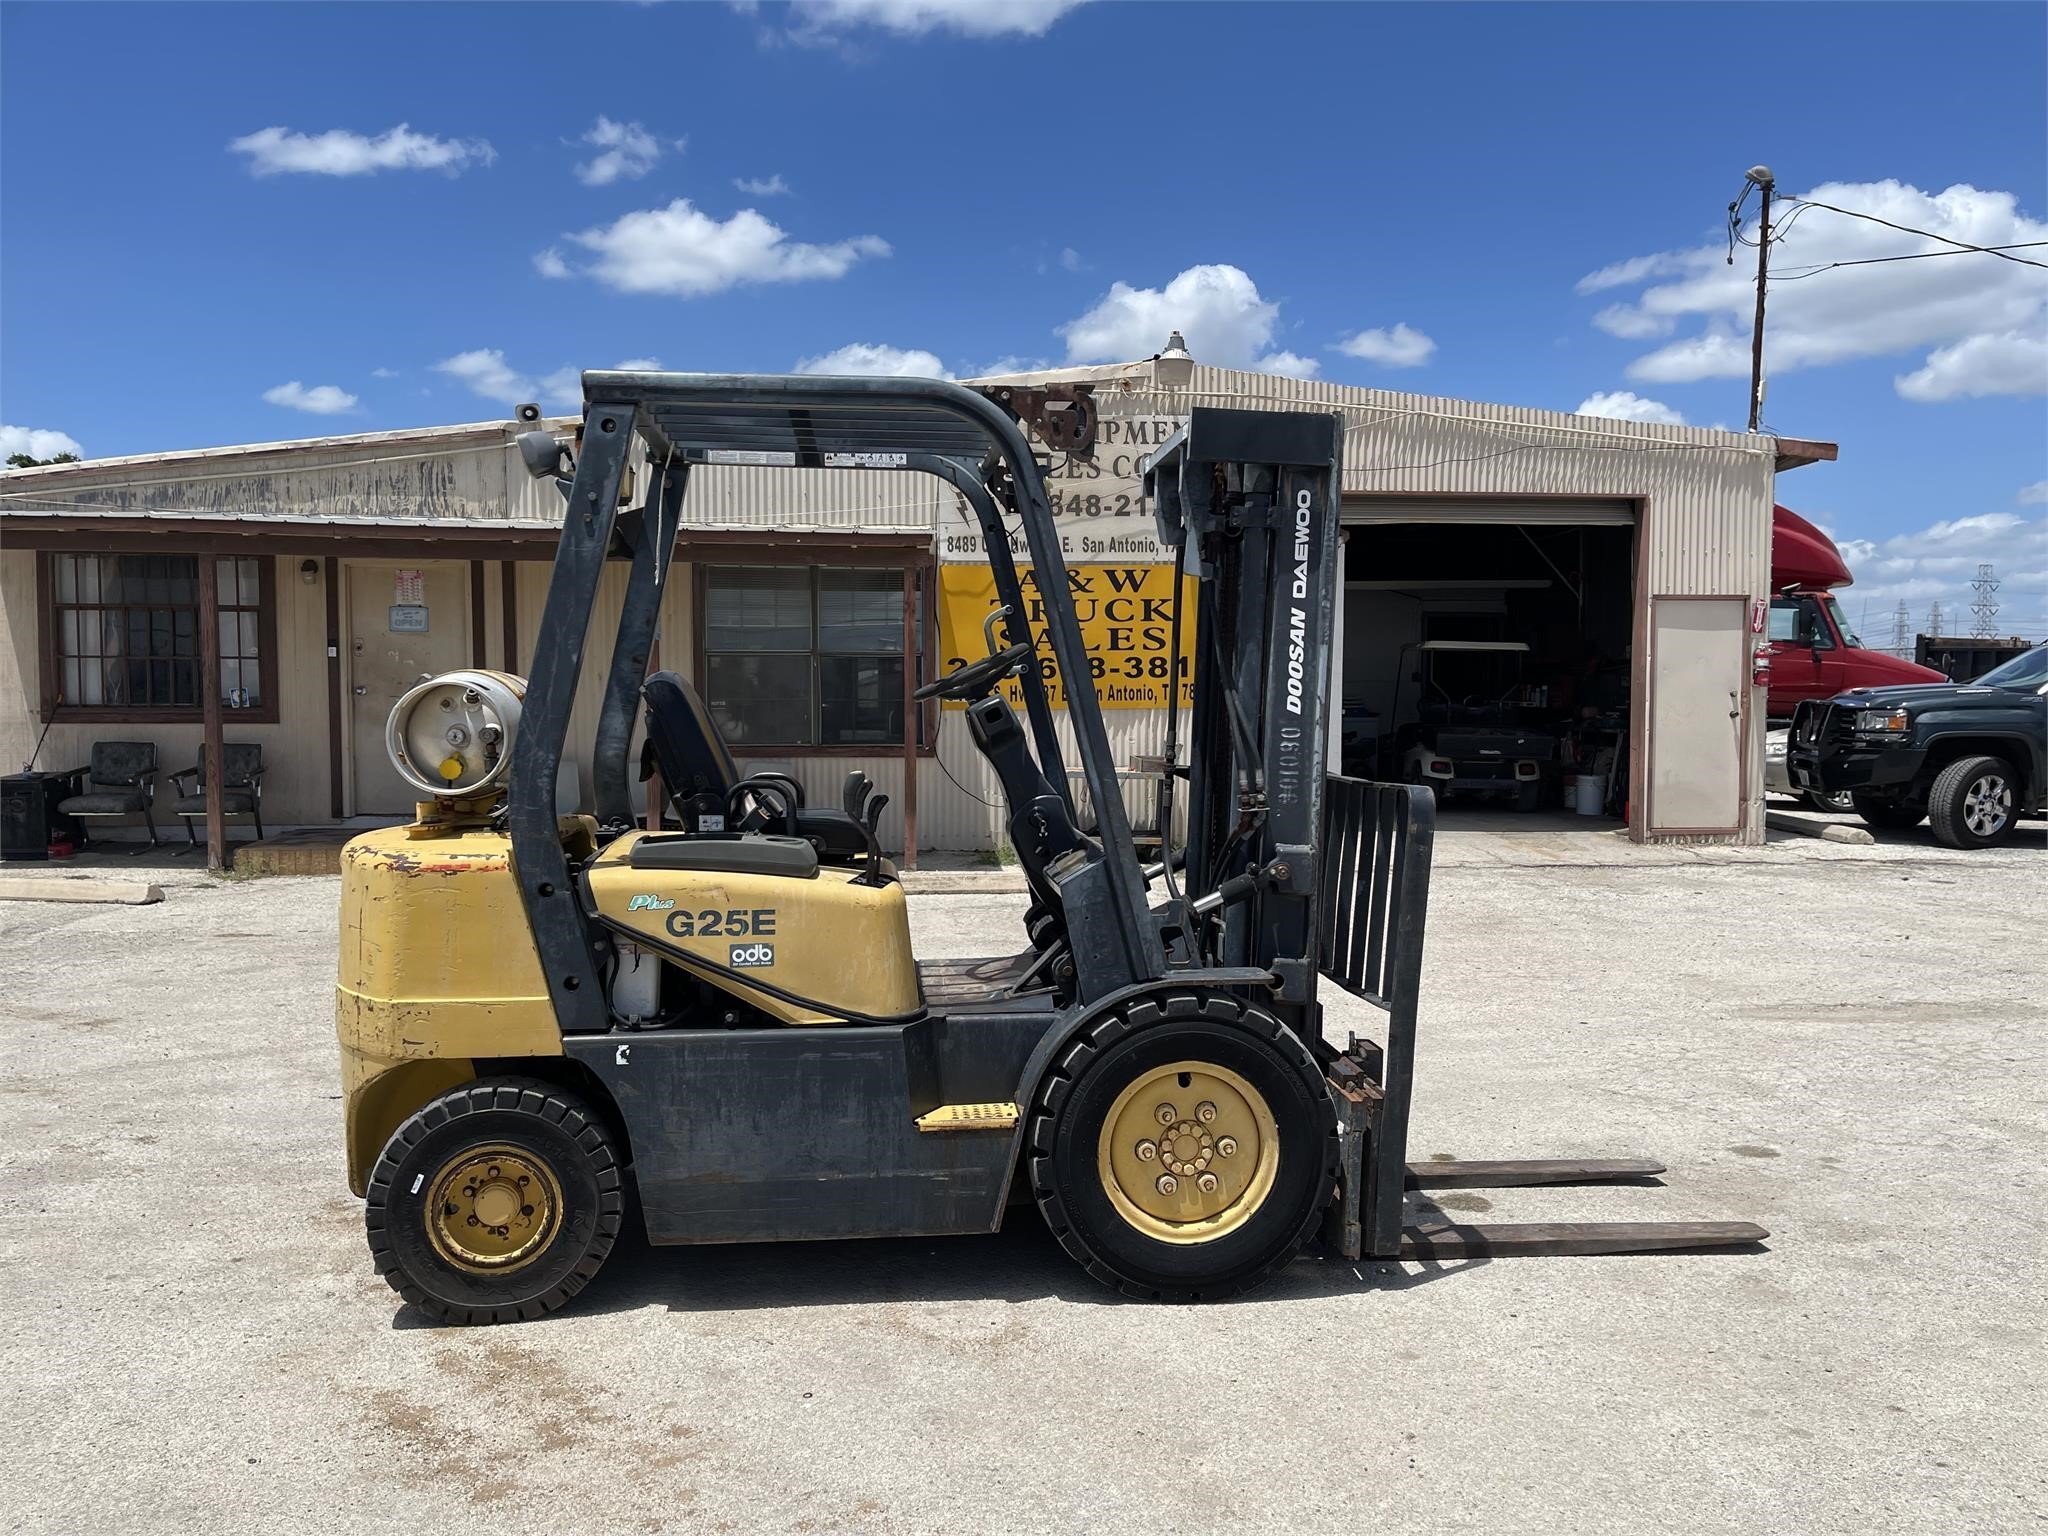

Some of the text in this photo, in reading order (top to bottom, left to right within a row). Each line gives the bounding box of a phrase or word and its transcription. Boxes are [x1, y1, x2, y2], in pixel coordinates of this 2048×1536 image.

[947, 536, 977, 553] 8489
[1082, 536, 1104, 554] San
[1108, 536, 1159, 556] Antonio,
[1103, 569, 1151, 593] W
[1286, 489, 1311, 715] DOOSAN DAEWOO
[1107, 683, 1158, 705] Antonio,
[627, 893, 676, 912] Plus
[665, 908, 777, 938] G25E
[731, 944, 773, 962] odb
